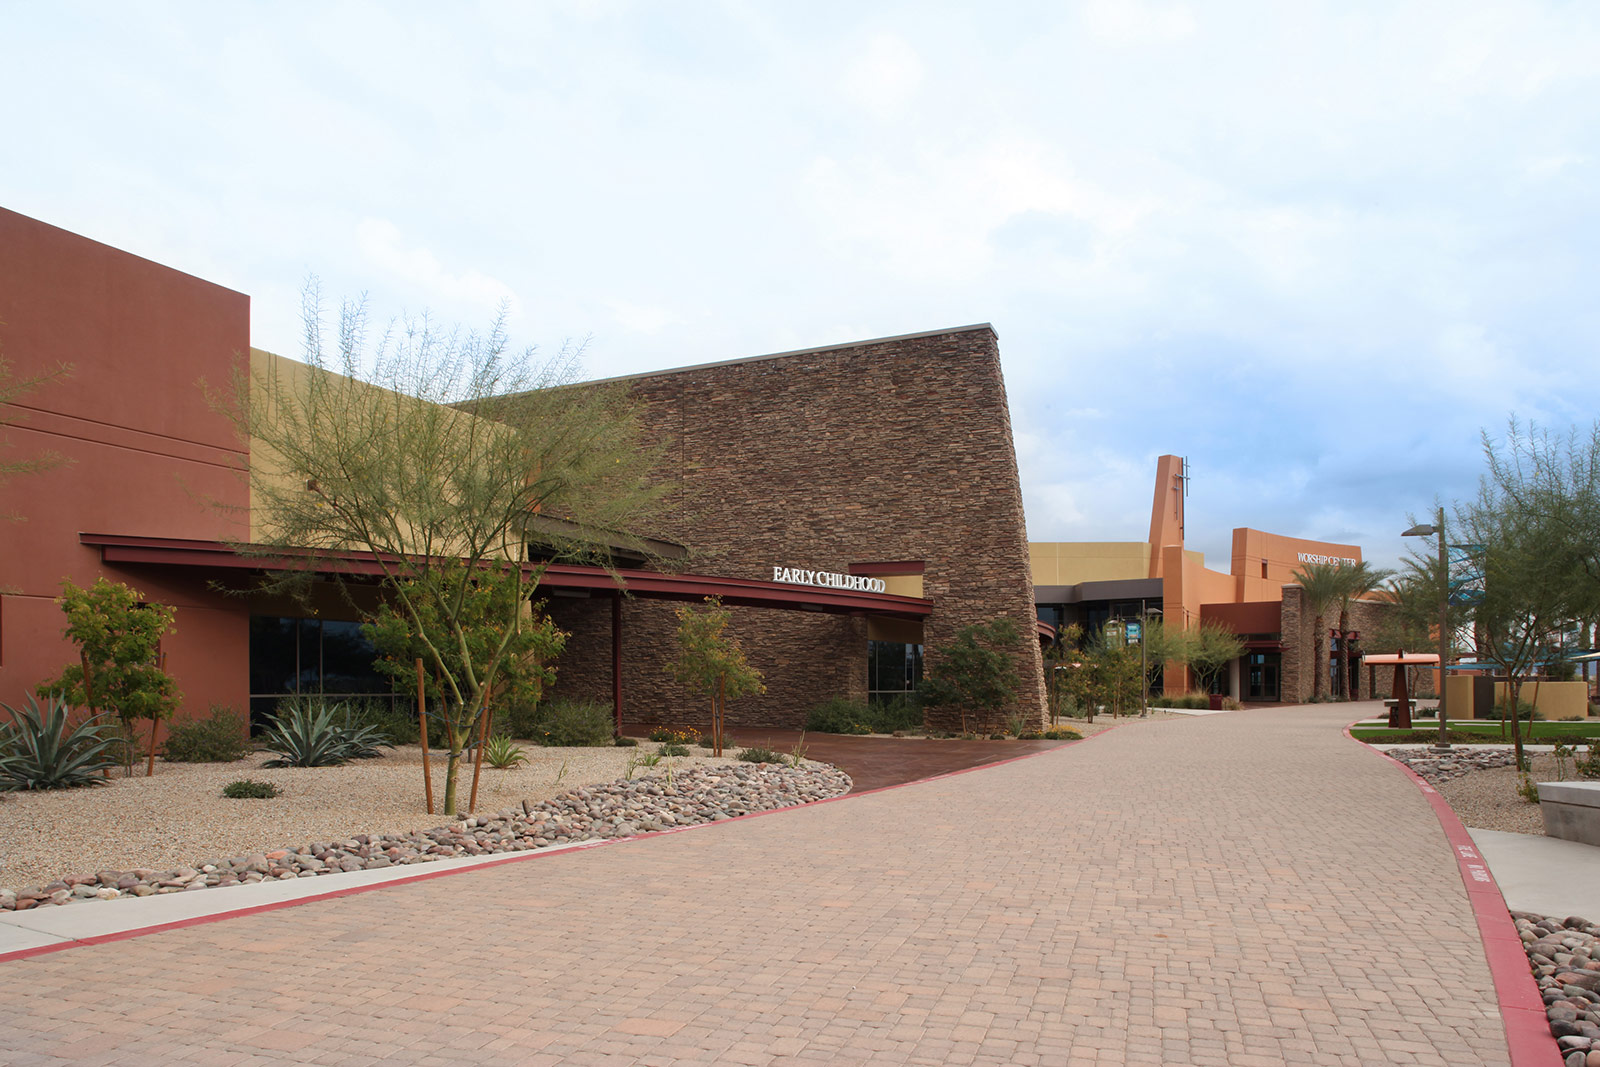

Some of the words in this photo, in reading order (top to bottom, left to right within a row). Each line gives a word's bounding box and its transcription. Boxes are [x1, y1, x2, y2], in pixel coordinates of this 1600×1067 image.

[1297, 552, 1328, 566] WORSHIP
[773, 566, 815, 585] EARLY
[816, 571, 886, 593] CHILDHOOD
